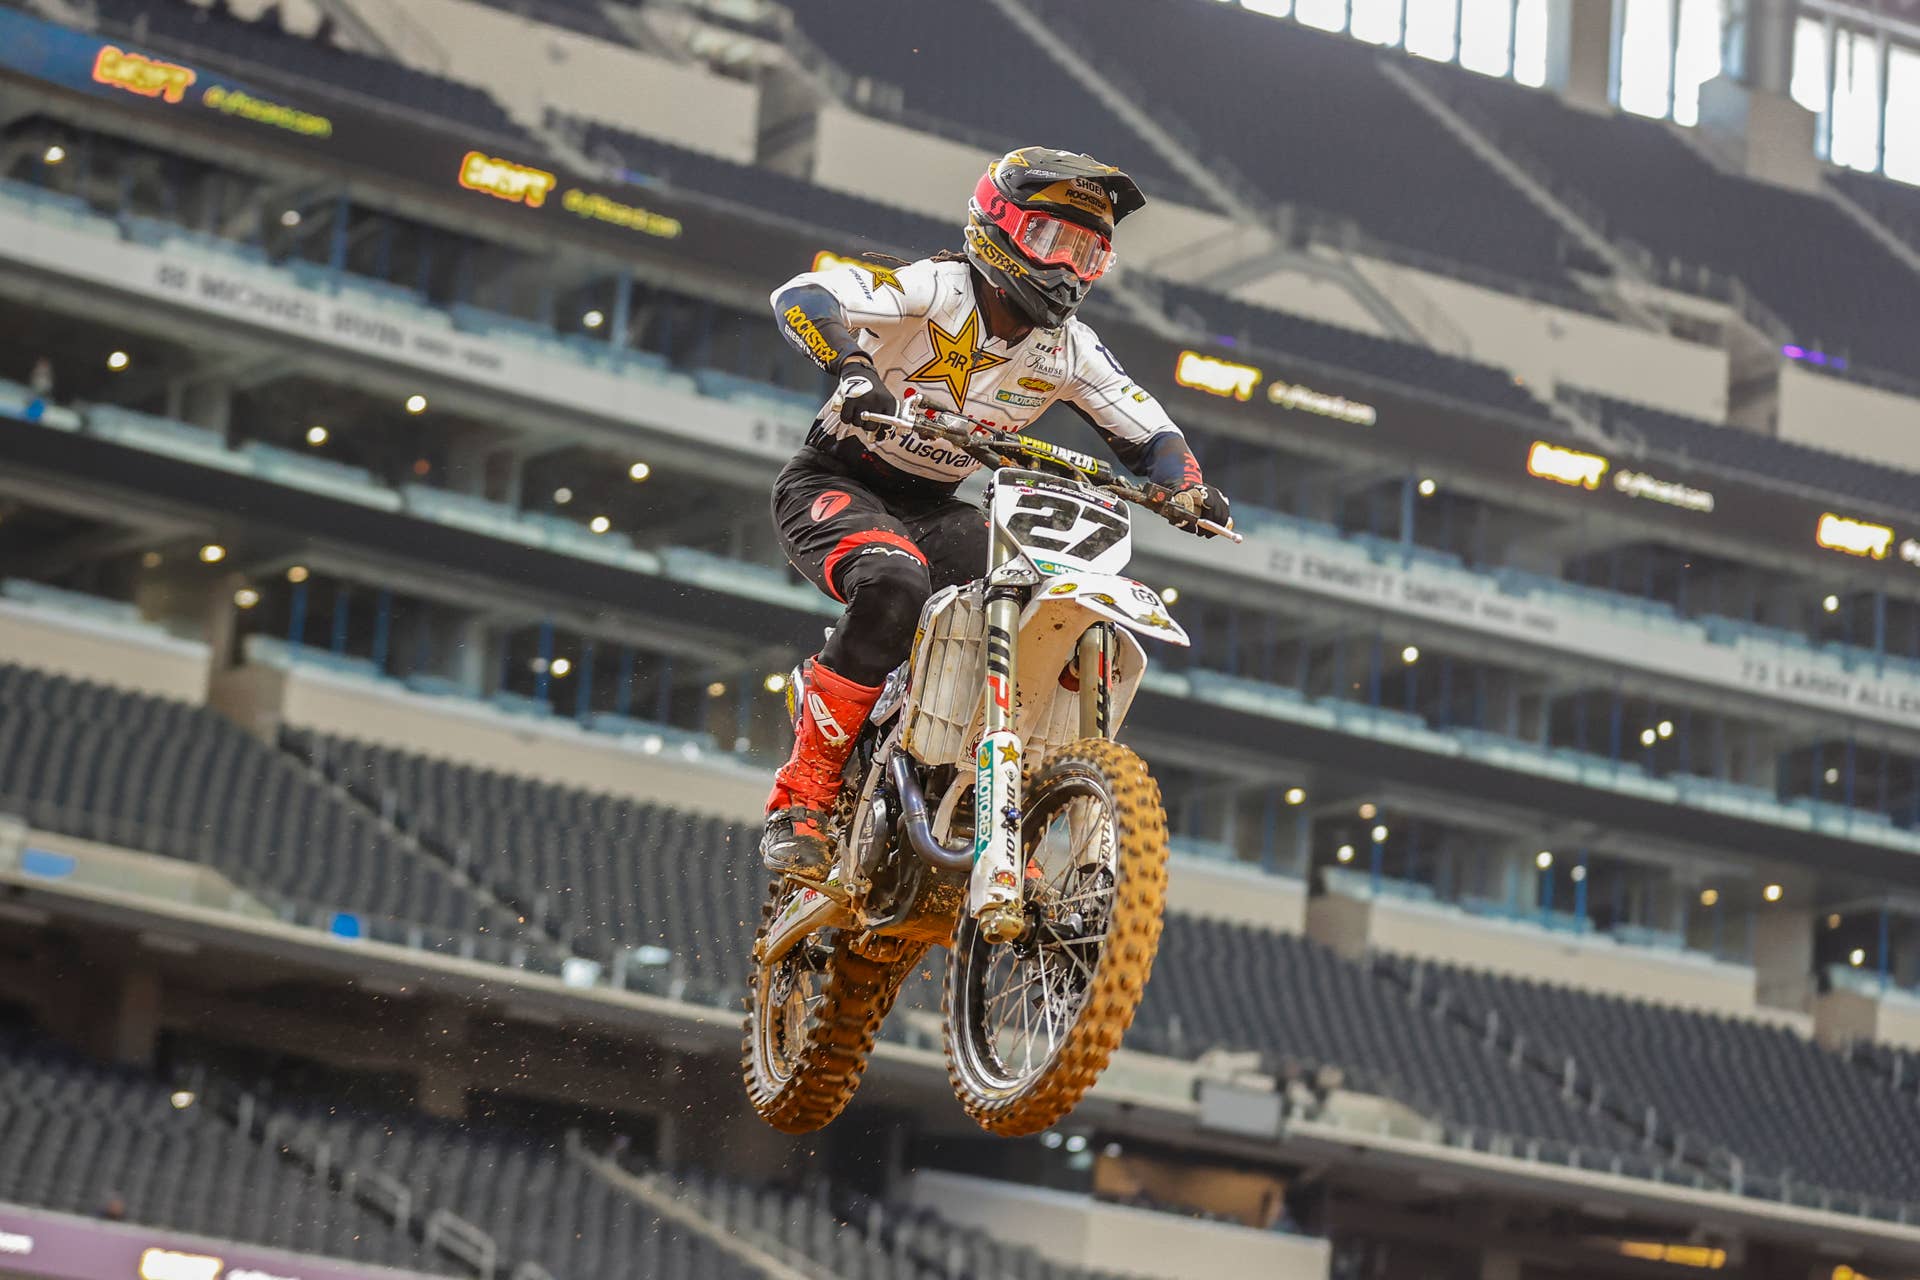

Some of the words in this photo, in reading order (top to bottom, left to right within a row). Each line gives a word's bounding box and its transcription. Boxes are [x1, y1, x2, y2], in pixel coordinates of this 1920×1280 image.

[1075, 178, 1103, 197] SHOEI
[784, 304, 838, 365] ROCKSTAR
[1006, 494, 1129, 562] 27
[977, 767, 993, 849] MOTOREX
[1005, 784, 1016, 867] DULOP
